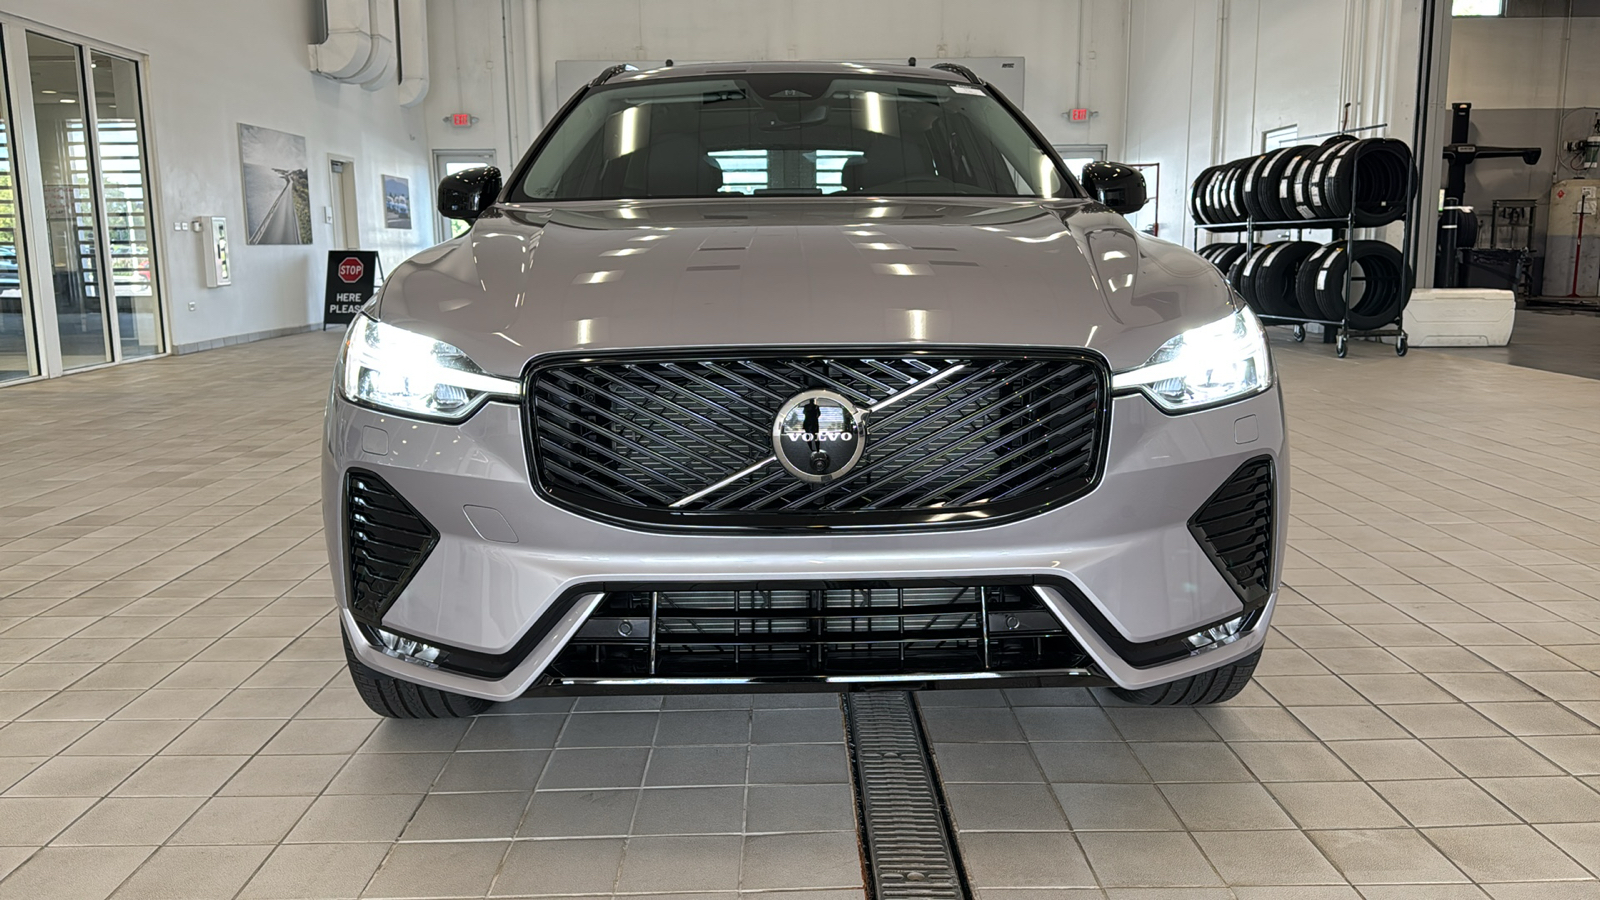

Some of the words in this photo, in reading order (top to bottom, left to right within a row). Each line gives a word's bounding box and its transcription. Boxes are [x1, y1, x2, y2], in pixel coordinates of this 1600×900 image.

[1072, 109, 1087, 120] EXIT
[340, 265, 362, 275] STOP
[336, 293, 362, 302] HERE
[329, 304, 363, 314] PLEAS
[786, 432, 853, 441] VOLVO
